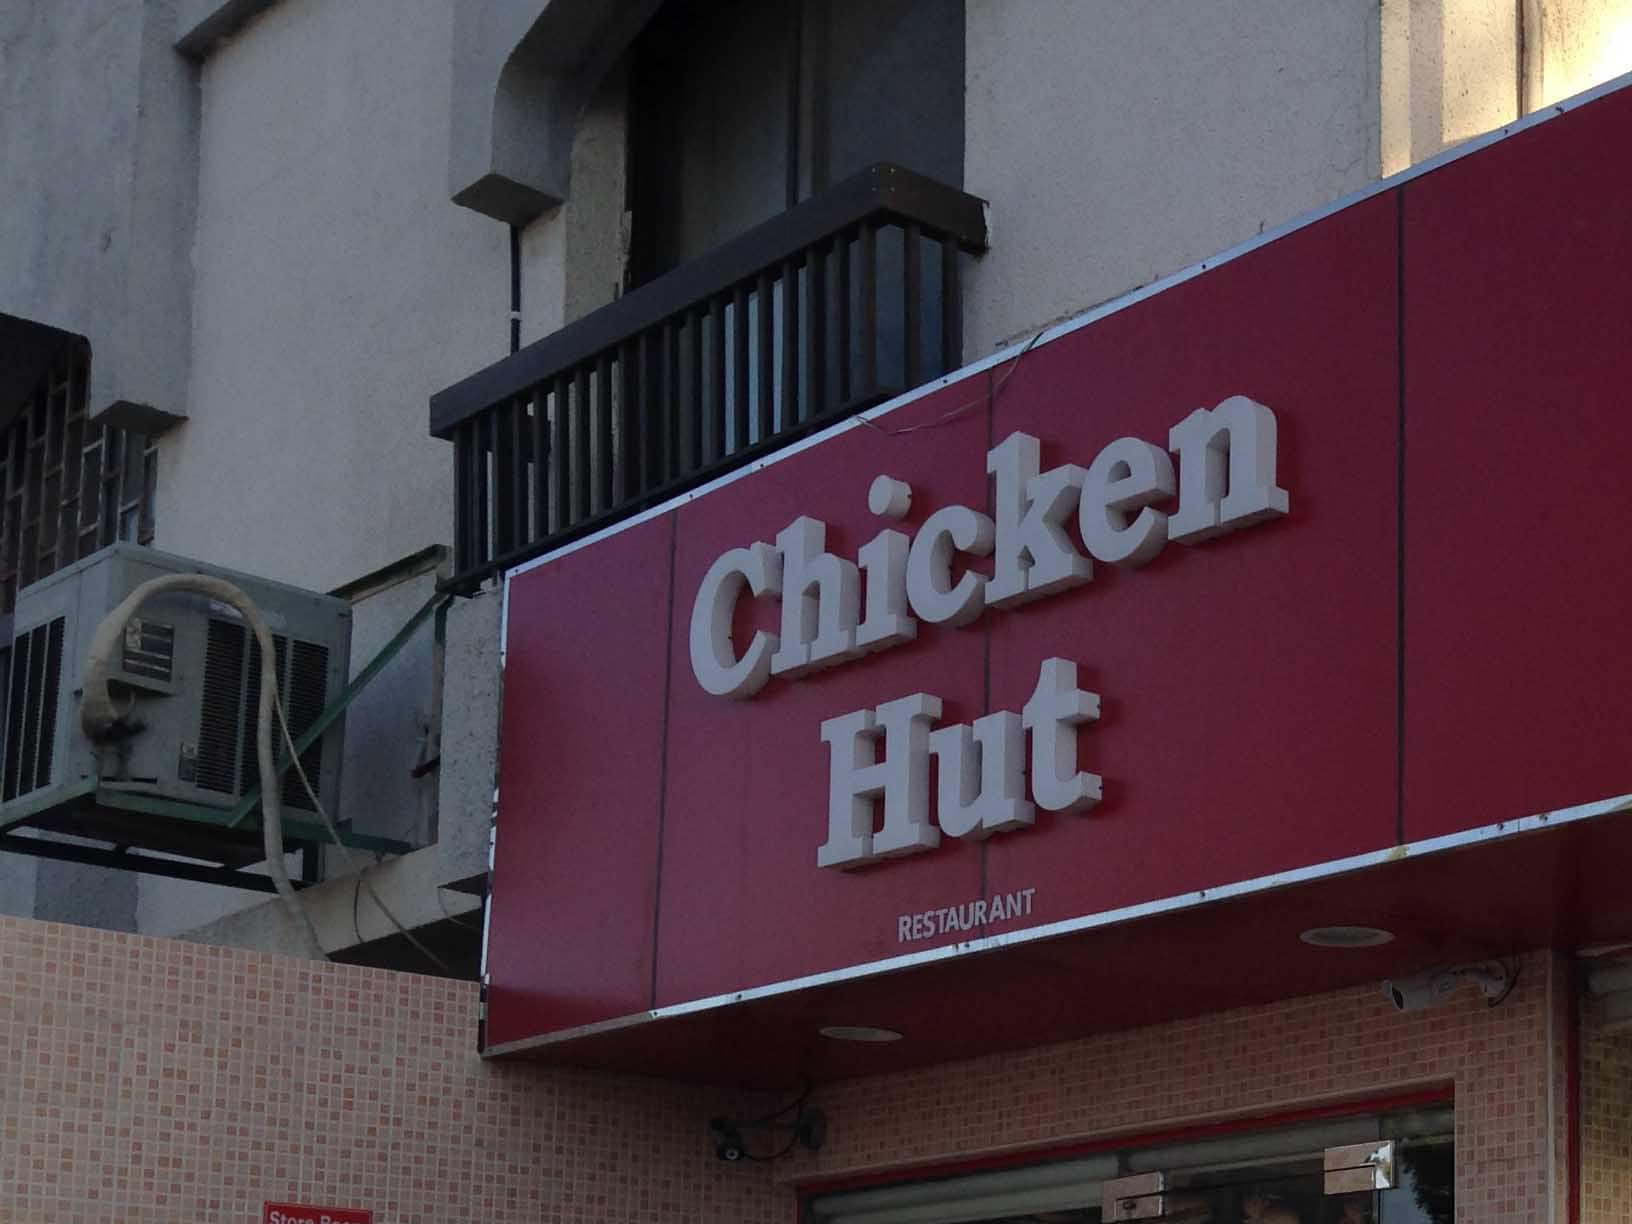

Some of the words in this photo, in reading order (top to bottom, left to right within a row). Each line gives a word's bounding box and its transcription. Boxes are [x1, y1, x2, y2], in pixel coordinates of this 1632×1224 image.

[689, 395, 1289, 700] Chicken
[817, 656, 1102, 869] Hut
[898, 888, 1036, 943] RESTAURANT
